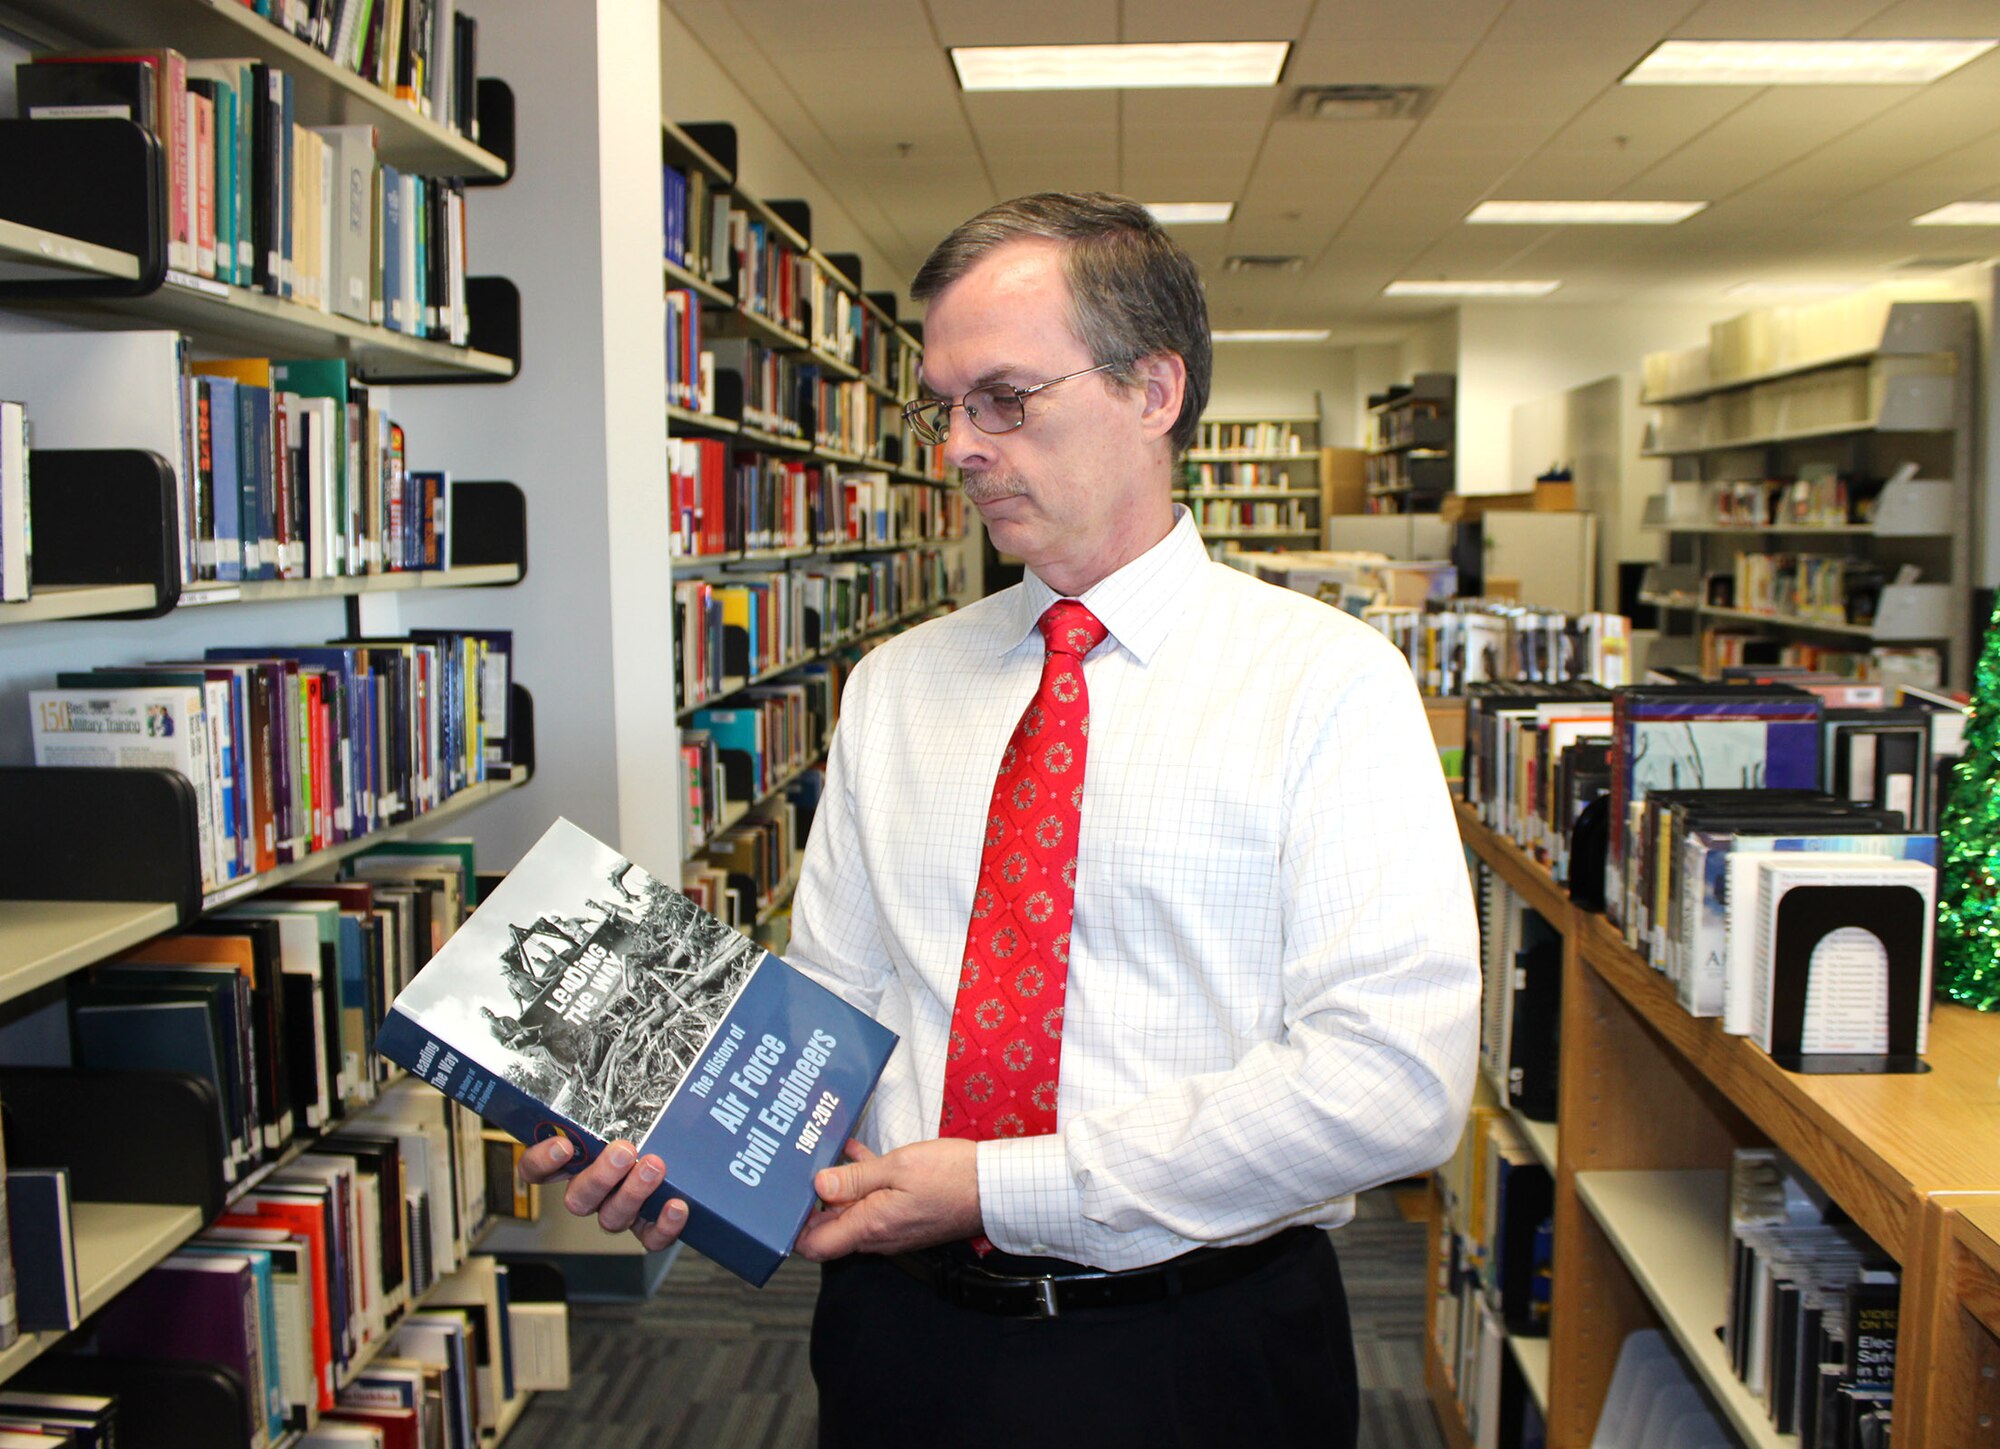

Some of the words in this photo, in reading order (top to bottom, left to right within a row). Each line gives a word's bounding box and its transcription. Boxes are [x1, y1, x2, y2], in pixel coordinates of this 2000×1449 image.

[40, 701, 72, 733] 150
[70, 717, 102, 734] Military
[104, 717, 141, 734] Training
[412, 1040, 440, 1078] Leading
[438, 1051, 459, 1074] Way
[689, 1075, 715, 1099] The
[703, 1036, 740, 1078] History
[730, 1022, 746, 1041] of
[729, 1033, 786, 1099] Force
[431, 1072, 449, 1089] The
[709, 1091, 751, 1135] Air
[729, 1126, 781, 1187] Civil
[757, 1029, 837, 1136] Engineers
[795, 1091, 840, 1155] 1907-2012
[1859, 1309, 1895, 1319] VIDE
[1857, 1365, 1873, 1377] in
